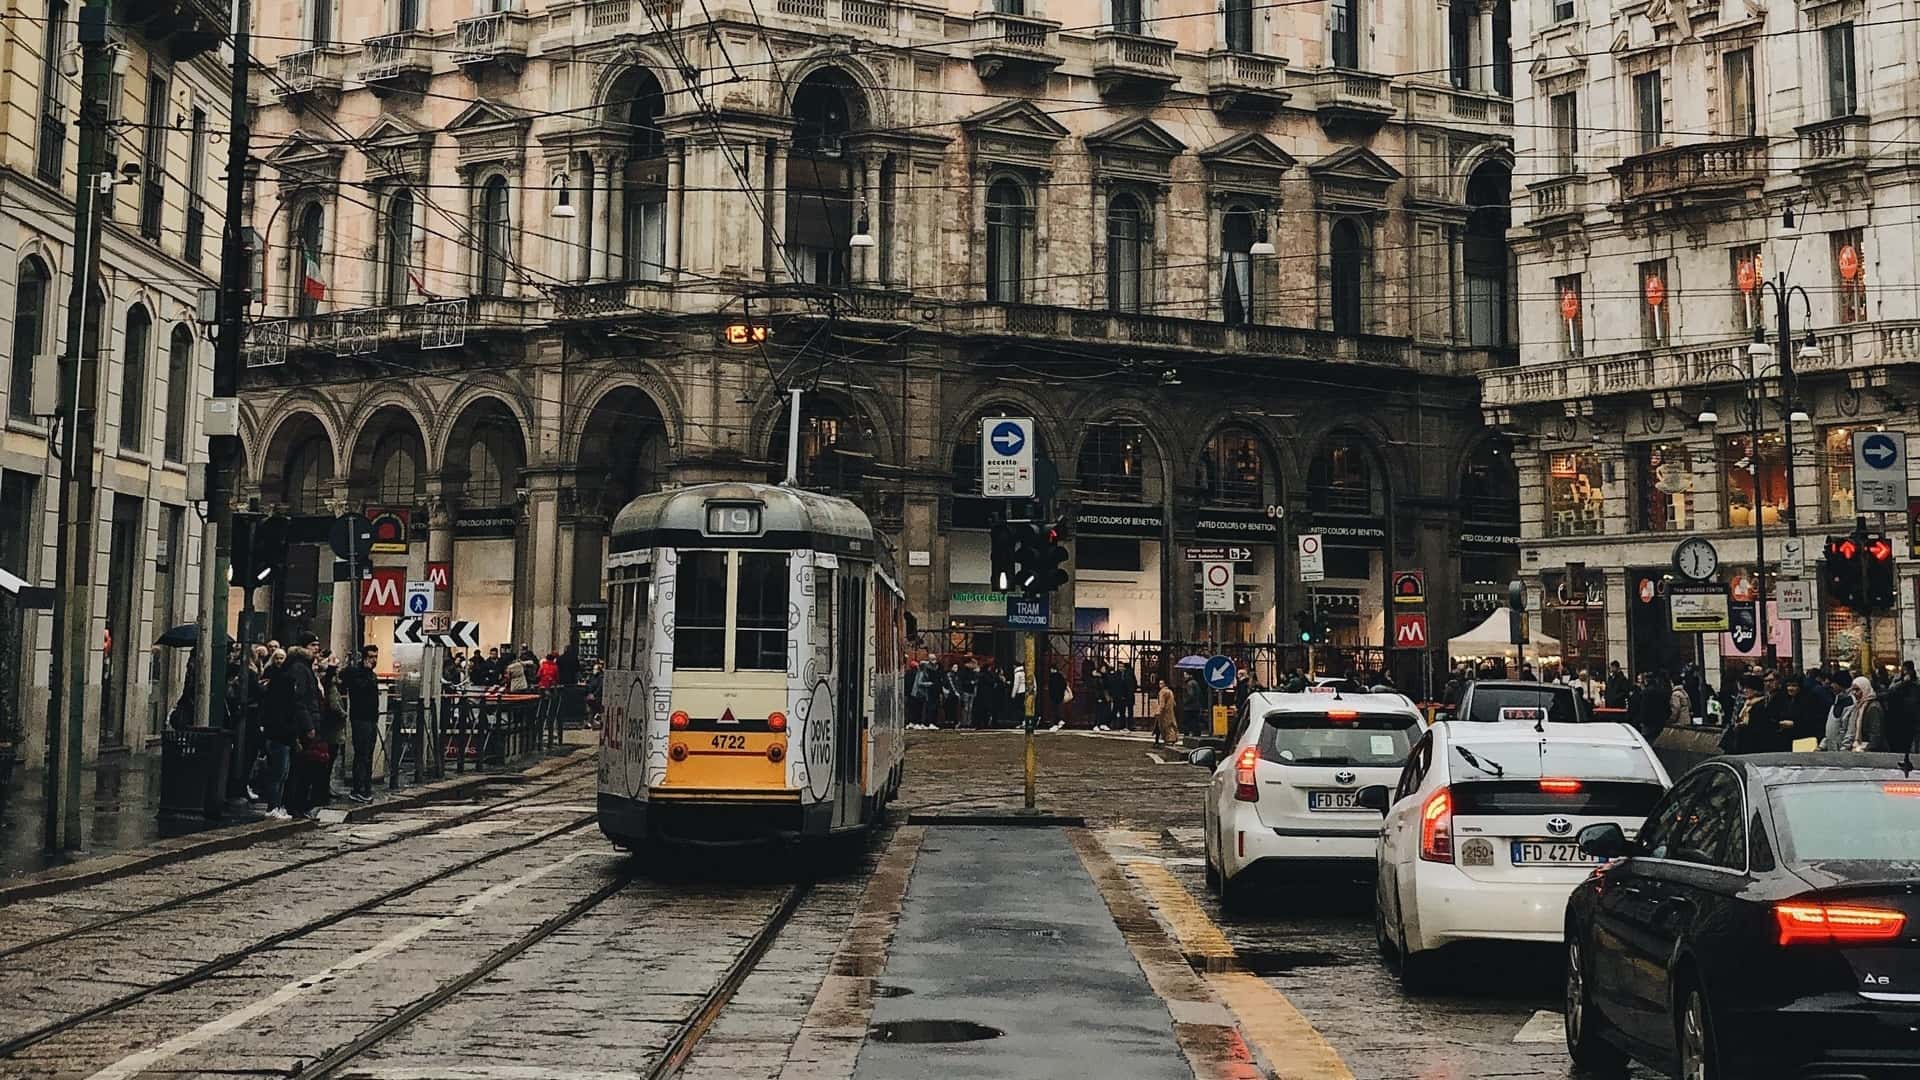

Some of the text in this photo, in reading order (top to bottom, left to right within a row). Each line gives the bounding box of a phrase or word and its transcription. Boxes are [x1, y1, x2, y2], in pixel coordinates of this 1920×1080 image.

[718, 510, 751, 532] 19
[1076, 515, 1098, 524] UNITED
[1099, 516, 1122, 525] COLORS
[1123, 517, 1131, 525] OF
[1216, 521, 1239, 530] COLORS
[1239, 522, 1247, 530] OF
[1328, 527, 1349, 536] COLORS
[1349, 528, 1357, 536] OF
[430, 568, 447, 586] M
[364, 579, 401, 606] M
[1016, 602, 1040, 615] TRAM
[1398, 621, 1424, 641] M
[1505, 710, 1541, 719] TAX
[811, 723, 831, 741] DOVE
[711, 735, 746, 750] 4722
[811, 744, 831, 765] VIVO
[1317, 794, 1333, 807] FD
[1467, 846, 1489, 859] 2150
[1523, 844, 1543, 862] FD
[1863, 972, 1890, 985] A6
